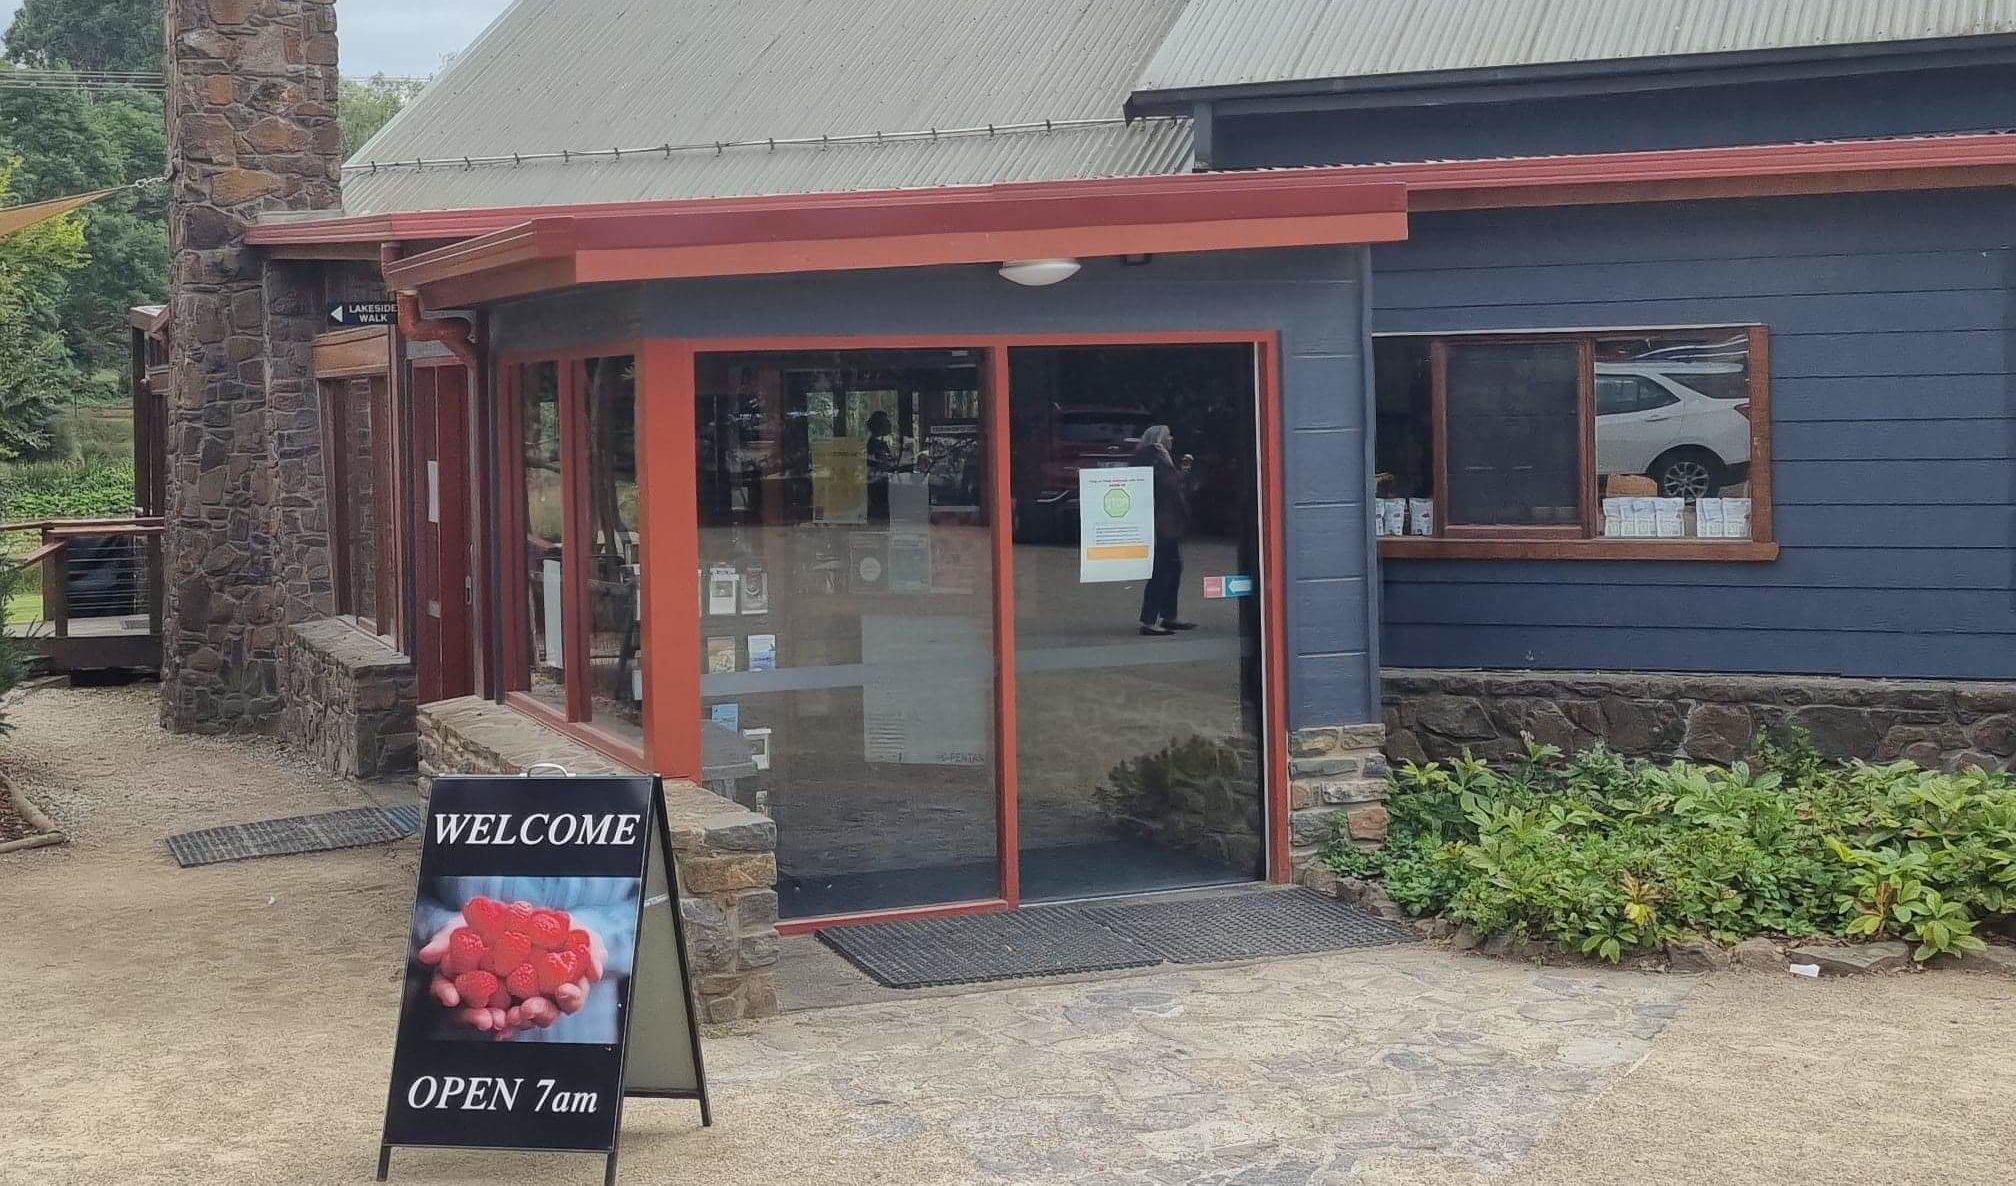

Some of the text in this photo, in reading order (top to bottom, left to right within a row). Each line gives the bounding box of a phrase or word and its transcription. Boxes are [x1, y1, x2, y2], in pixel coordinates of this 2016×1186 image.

[349, 305, 397, 313] LAKESIDE
[359, 314, 387, 322] WALK
[434, 813, 641, 846] WELCOME
[407, 1075, 599, 1114] OPEN 7am
